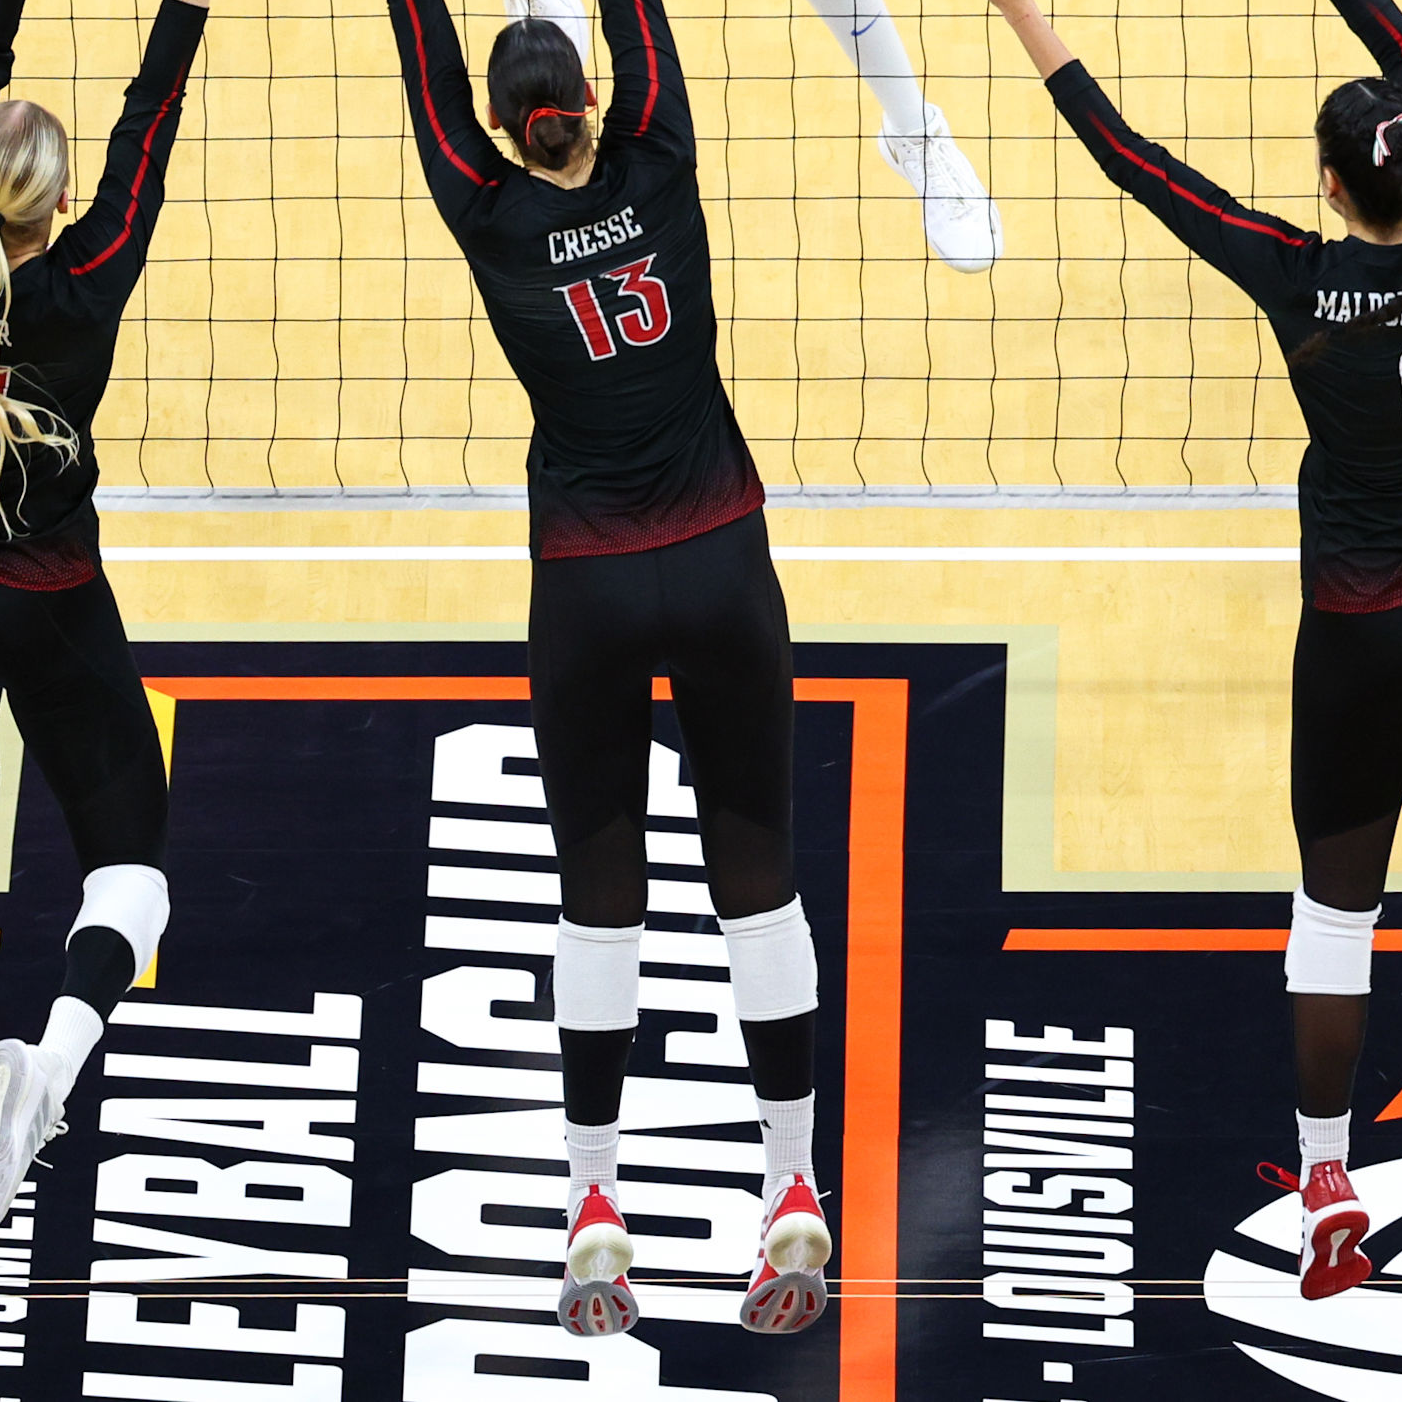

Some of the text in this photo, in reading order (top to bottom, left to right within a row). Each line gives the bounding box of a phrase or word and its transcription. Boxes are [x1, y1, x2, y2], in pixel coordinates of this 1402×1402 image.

[548, 206, 644, 265] CRESSE
[552, 252, 672, 362] 13
[982, 1018, 1135, 1347] LOUISVILLE
